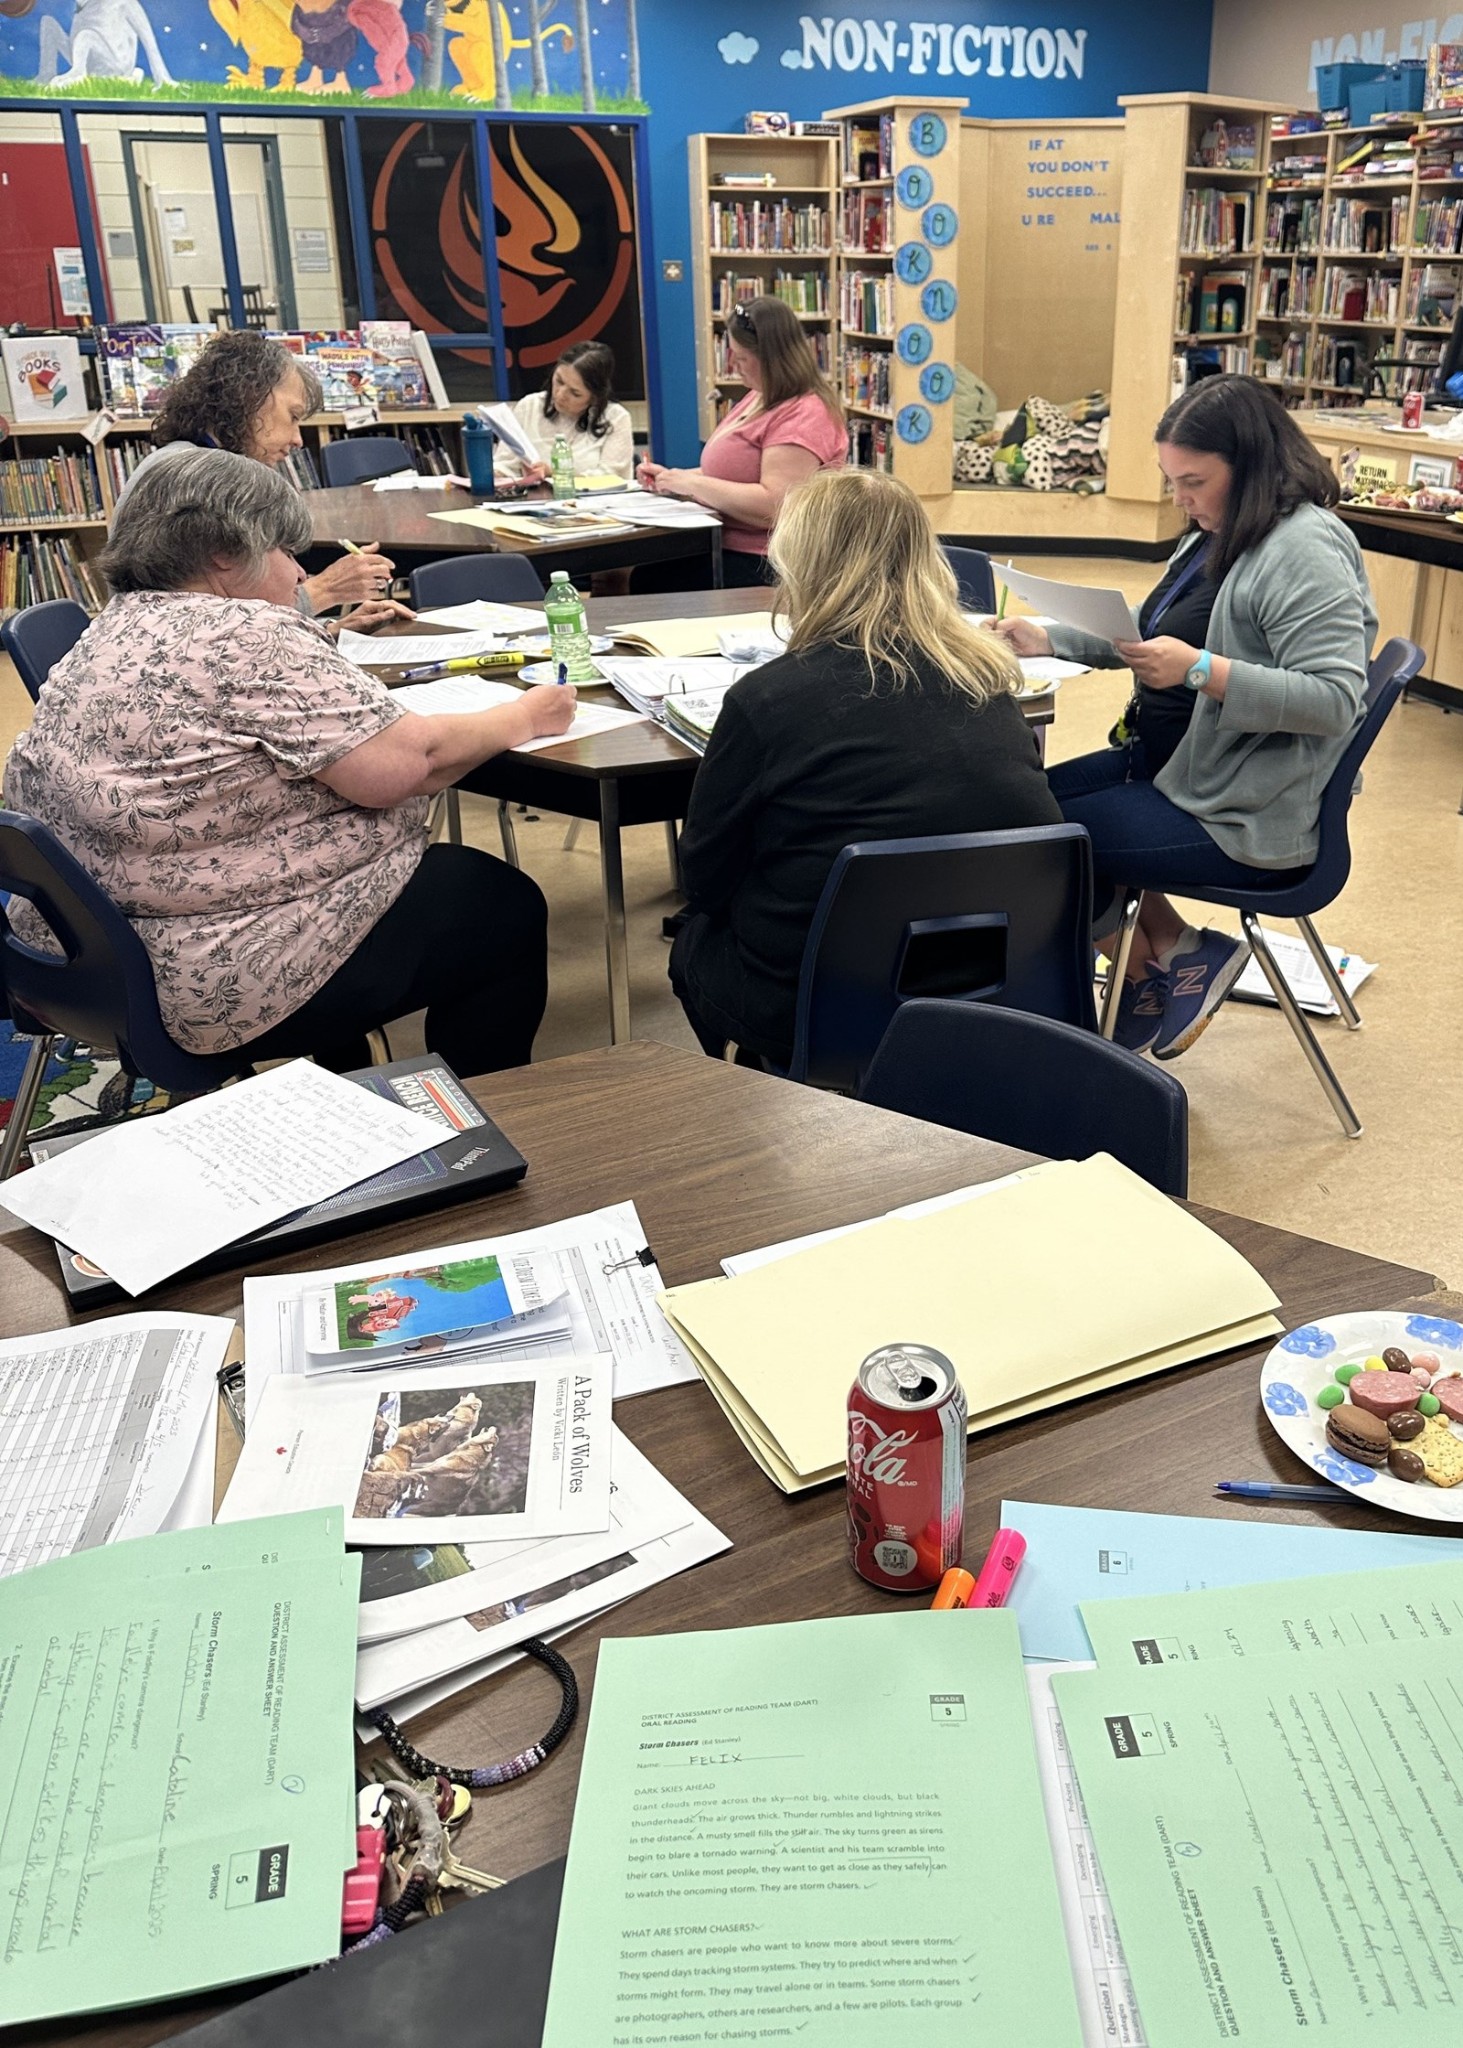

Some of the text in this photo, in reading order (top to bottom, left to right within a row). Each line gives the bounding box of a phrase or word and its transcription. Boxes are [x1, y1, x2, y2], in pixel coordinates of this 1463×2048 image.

[799, 15, 1088, 80] NON-FICTION
[1029, 139, 1065, 150] IF AT
[1028, 160, 1109, 173] YOU DON'T
[18, 358, 61, 384] BOOKS
[1360, 465, 1387, 478] RETURN
[1172, 964, 1208, 997] N
[556, 1377, 567, 1406] Written
[553, 1408, 565, 1418] by
[553, 1420, 564, 1440] Vicki
[569, 1375, 592, 1494] A Pack of Wolves
[210, 1610, 222, 1638] Storm
[204, 1639, 219, 1677] Chasers
[263, 1602, 281, 1717] QUESTION AND ANSWER SHEET
[264, 1600, 292, 1786] DISTRICT ASSESSMENT OF READING TEAM (DART)
[1368, 1691, 1380, 1707] know
[642, 1712, 673, 1721] DISTRICT
[675, 1708, 721, 1718] ASSESSMENT
[735, 1704, 768, 1712] READING
[770, 1701, 791, 1709] TEAM
[793, 1699, 818, 1707] (DART)
[945, 1707, 952, 1716] 5
[1377, 1707, 1388, 1719] you
[663, 1718, 696, 1726] READING
[1382, 1719, 1396, 1739] things
[639, 1741, 664, 1750] Storm
[665, 1739, 699, 1748] Chasers
[1112, 1721, 1129, 1752] GRADE
[1142, 1730, 1153, 1738] 5
[1163, 1720, 1178, 1748] SPRING
[1393, 1739, 1402, 1751] two
[689, 1753, 743, 1766] FELIX
[1399, 1752, 1408, 1763] are
[1403, 1764, 1417, 1782] What
[634, 1782, 715, 1796] DARK SKIES AHEAD
[632, 1800, 656, 1811] Giant
[661, 1798, 689, 1809] clouds
[694, 1799, 717, 1807] move
[721, 1797, 748, 1805] across
[752, 1793, 766, 1803] the
[813, 1792, 828, 1804] big,
[834, 1791, 858, 1801] white
[862, 1791, 892, 1803] clouds,
[898, 1791, 912, 1801] but
[916, 1791, 938, 1800] black
[1430, 1816, 1443, 1837] North
[209, 1863, 221, 1900] SPRING
[236, 1875, 248, 1884] 5
[268, 1853, 281, 1893] GRADE
[1308, 1856, 1329, 1902] dangerous?
[1155, 1815, 1229, 2038] DISTRICT ASSESSMENT OF READING TEAM (DART)
[1326, 1903, 1341, 1933] camera
[621, 1923, 758, 1939] WHAT ARE STORM CHASERS?
[620, 1948, 647, 1959] Storm
[650, 1946, 683, 1957] chasers
[687, 1947, 702, 1955] are
[706, 1943, 737, 1956] people
[740, 1942, 761, 1952] who
[764, 1941, 787, 1951] want
[791, 1940, 801, 1950] to
[804, 1939, 829, 1949] know
[861, 1937, 887, 1947] about
[923, 1935, 957, 1946] storms.
[1187, 1888, 1240, 2037] QUESTION AND ANSWER SHEET
[1269, 1936, 1293, 1986] Chasers
[1357, 1984, 1368, 2004] Why
[1102, 1990, 1117, 2036] Question
[1288, 1988, 1308, 2026] Storm
